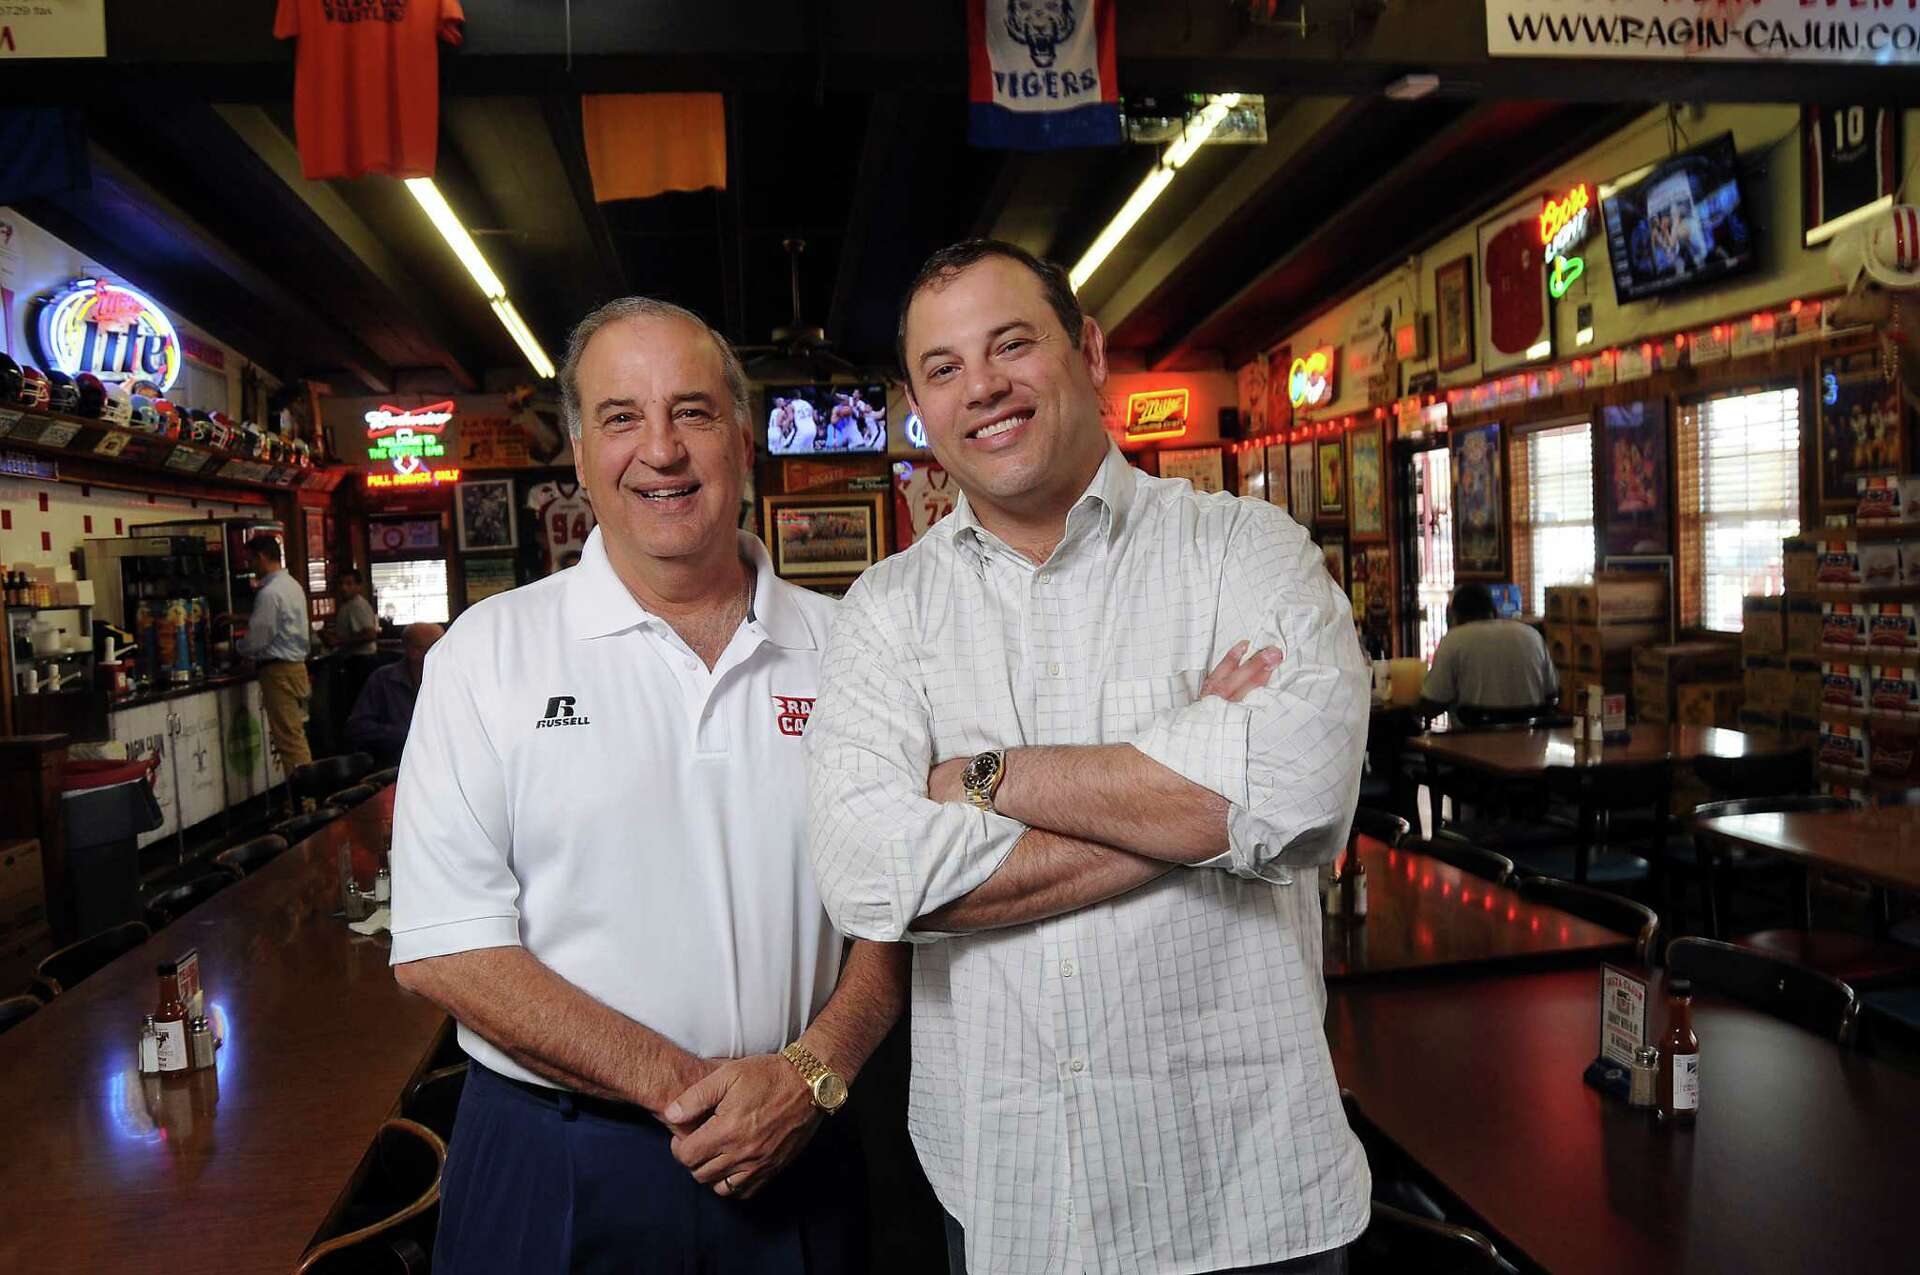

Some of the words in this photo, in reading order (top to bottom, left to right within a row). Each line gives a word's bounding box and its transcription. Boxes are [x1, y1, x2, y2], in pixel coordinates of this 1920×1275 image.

[1507, 14, 1920, 52] WWW.RAGIN-CAJUN.CO
[993, 68, 1097, 98] TIGERS
[1834, 105, 1864, 150] 10
[1539, 183, 1589, 245] Coors
[434, 469, 460, 481] ONLY
[551, 511, 588, 545] 94
[787, 700, 816, 714] RA
[536, 717, 590, 729] RUSSELL
[781, 717, 806, 731] CA
